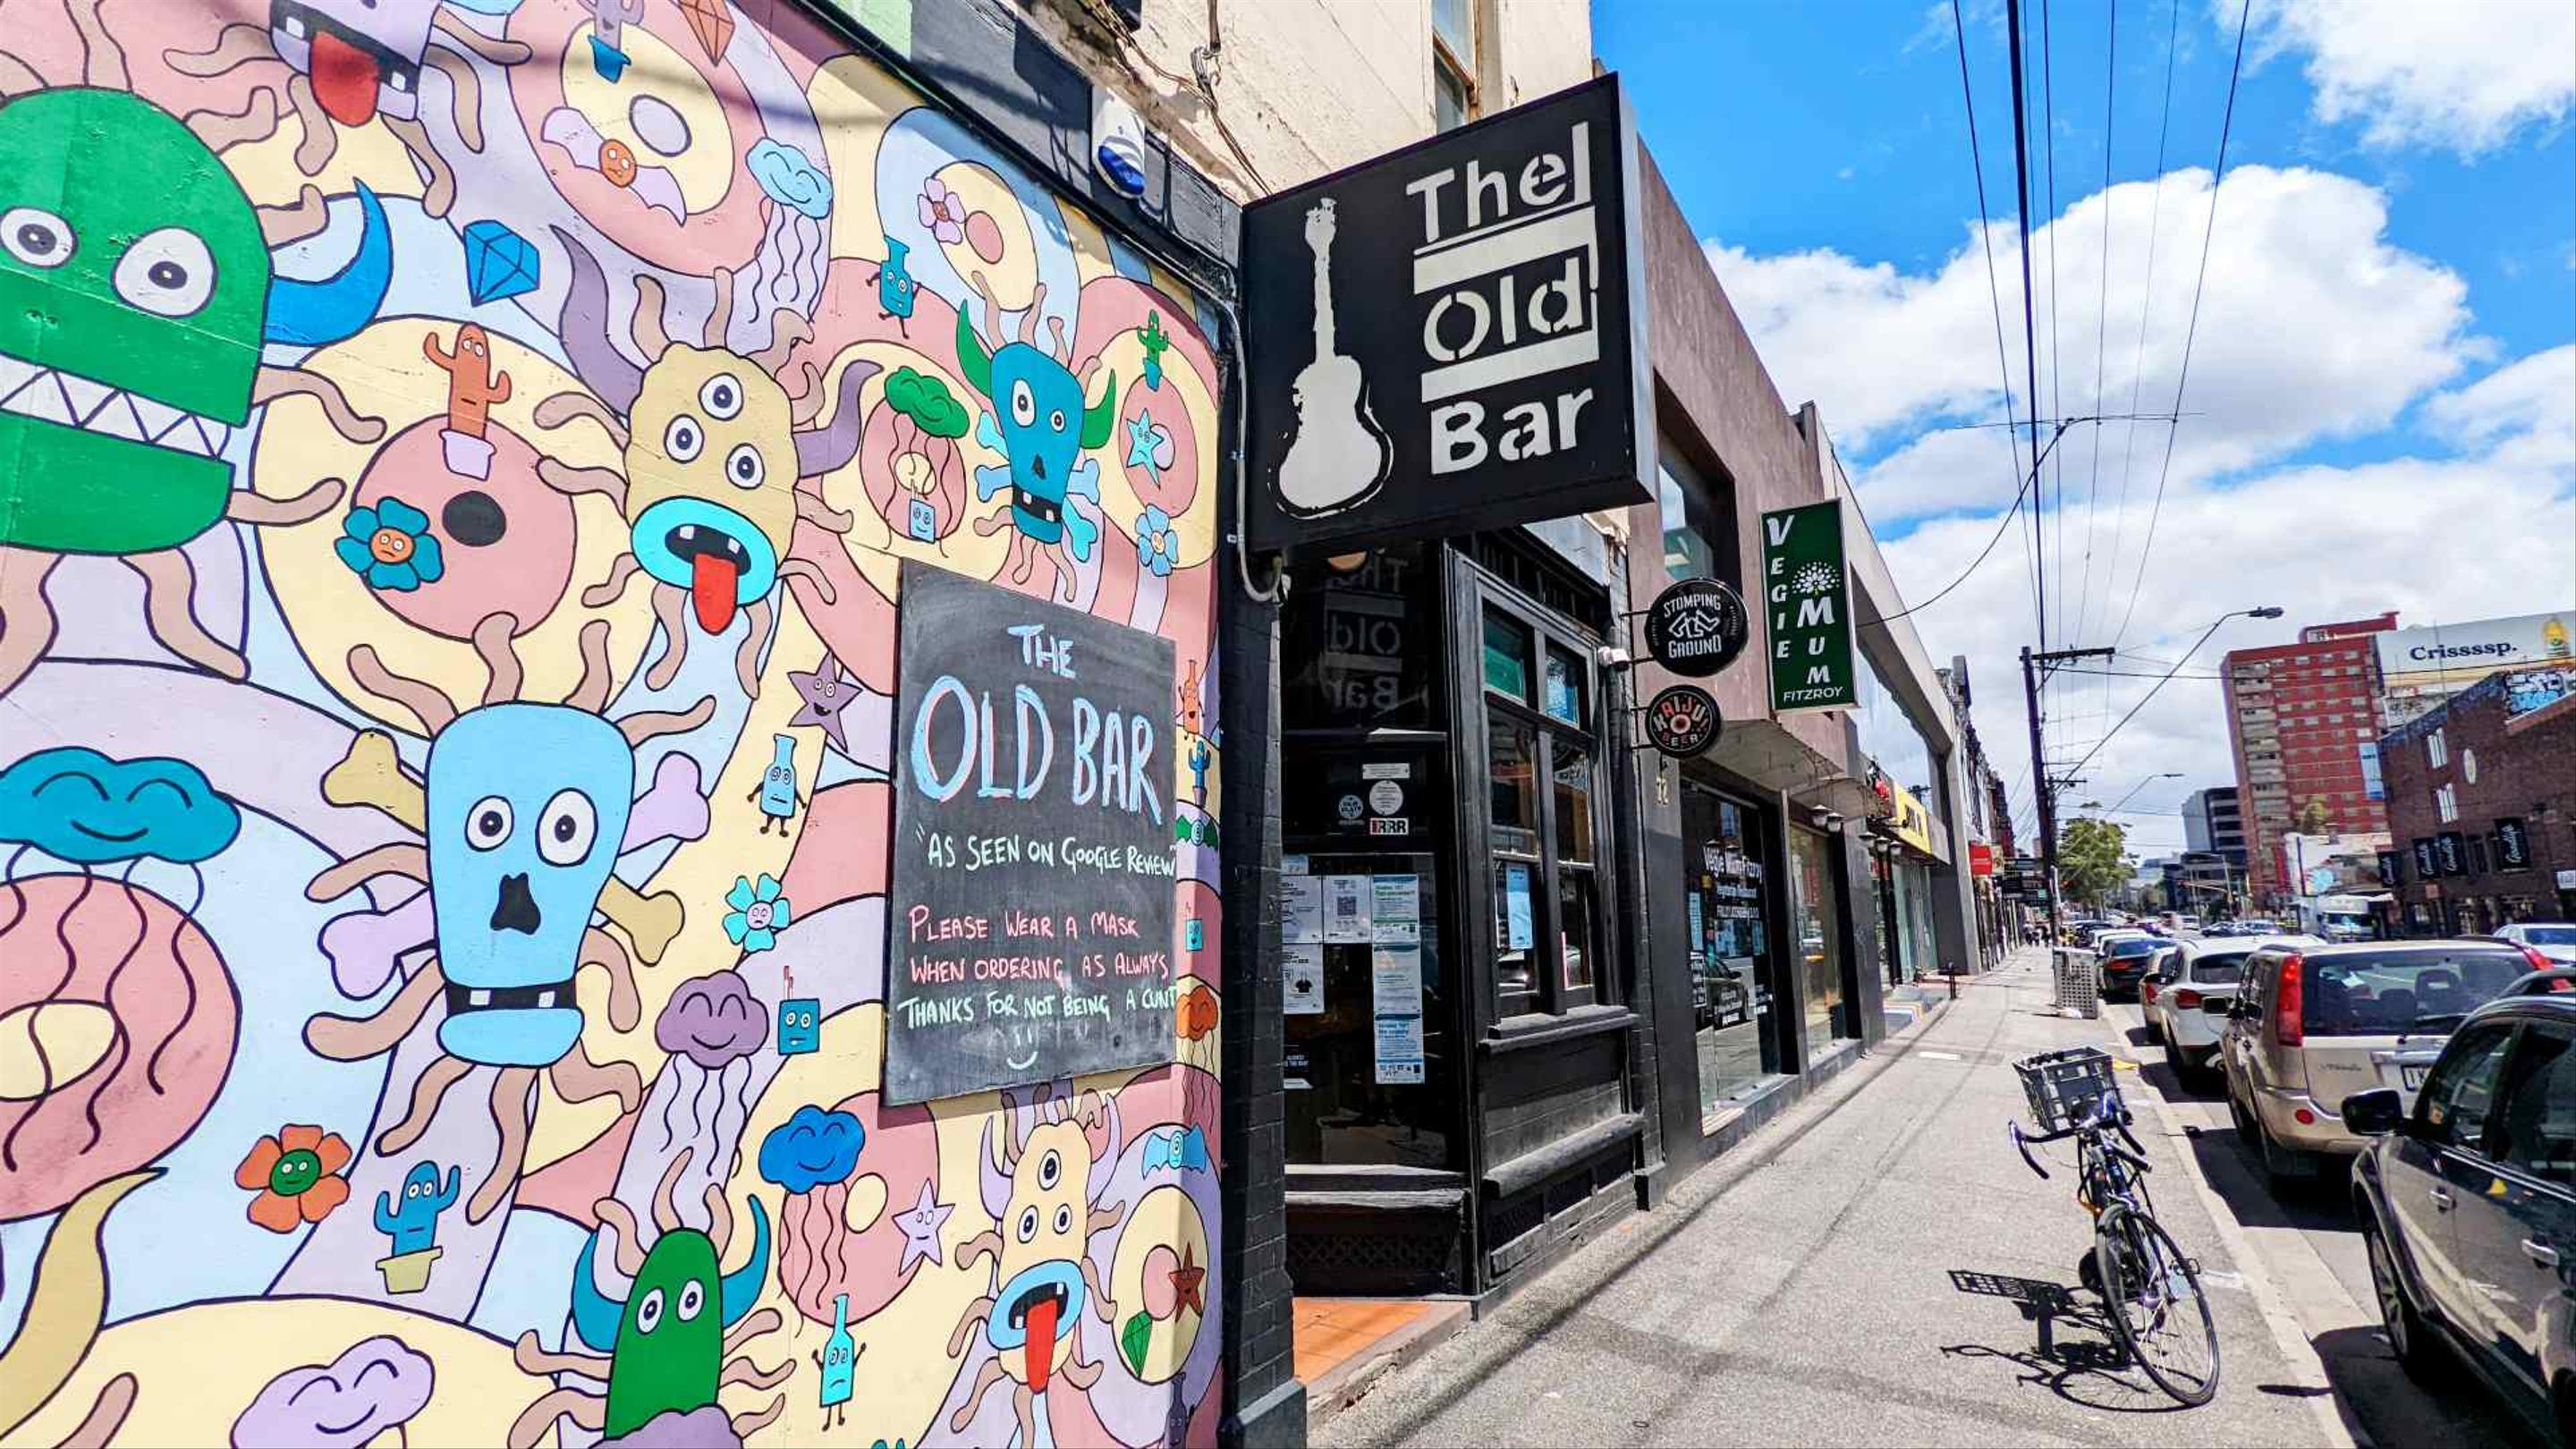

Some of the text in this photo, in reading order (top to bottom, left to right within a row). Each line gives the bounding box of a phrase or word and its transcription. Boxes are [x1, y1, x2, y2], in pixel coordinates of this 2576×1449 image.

[1406, 153, 1566, 243] The
[1424, 258, 1583, 361] Old
[1431, 387, 1594, 475] Bar
[1663, 592, 1723, 619] STOMPING
[1766, 514, 1795, 659] VEGIE
[1006, 623, 1076, 679] THE
[1667, 633, 1723, 659] GROUND
[1796, 596, 1836, 685] MUM
[2409, 640, 2518, 661] Crissssp.
[1783, 686, 1843, 703] FITZROY
[911, 675, 1162, 826] OLD BAR
[1662, 732, 1699, 747] BEER
[965, 834, 1020, 871] SEEN
[1028, 840, 1054, 867] ON
[909, 904, 1140, 942] PLEASE WEAR A MASK
[911, 951, 1169, 987] WHEN ORDERING AS ALWAYS
[897, 987, 1177, 1029] THANKS FOR NOT BEING A CUNT
